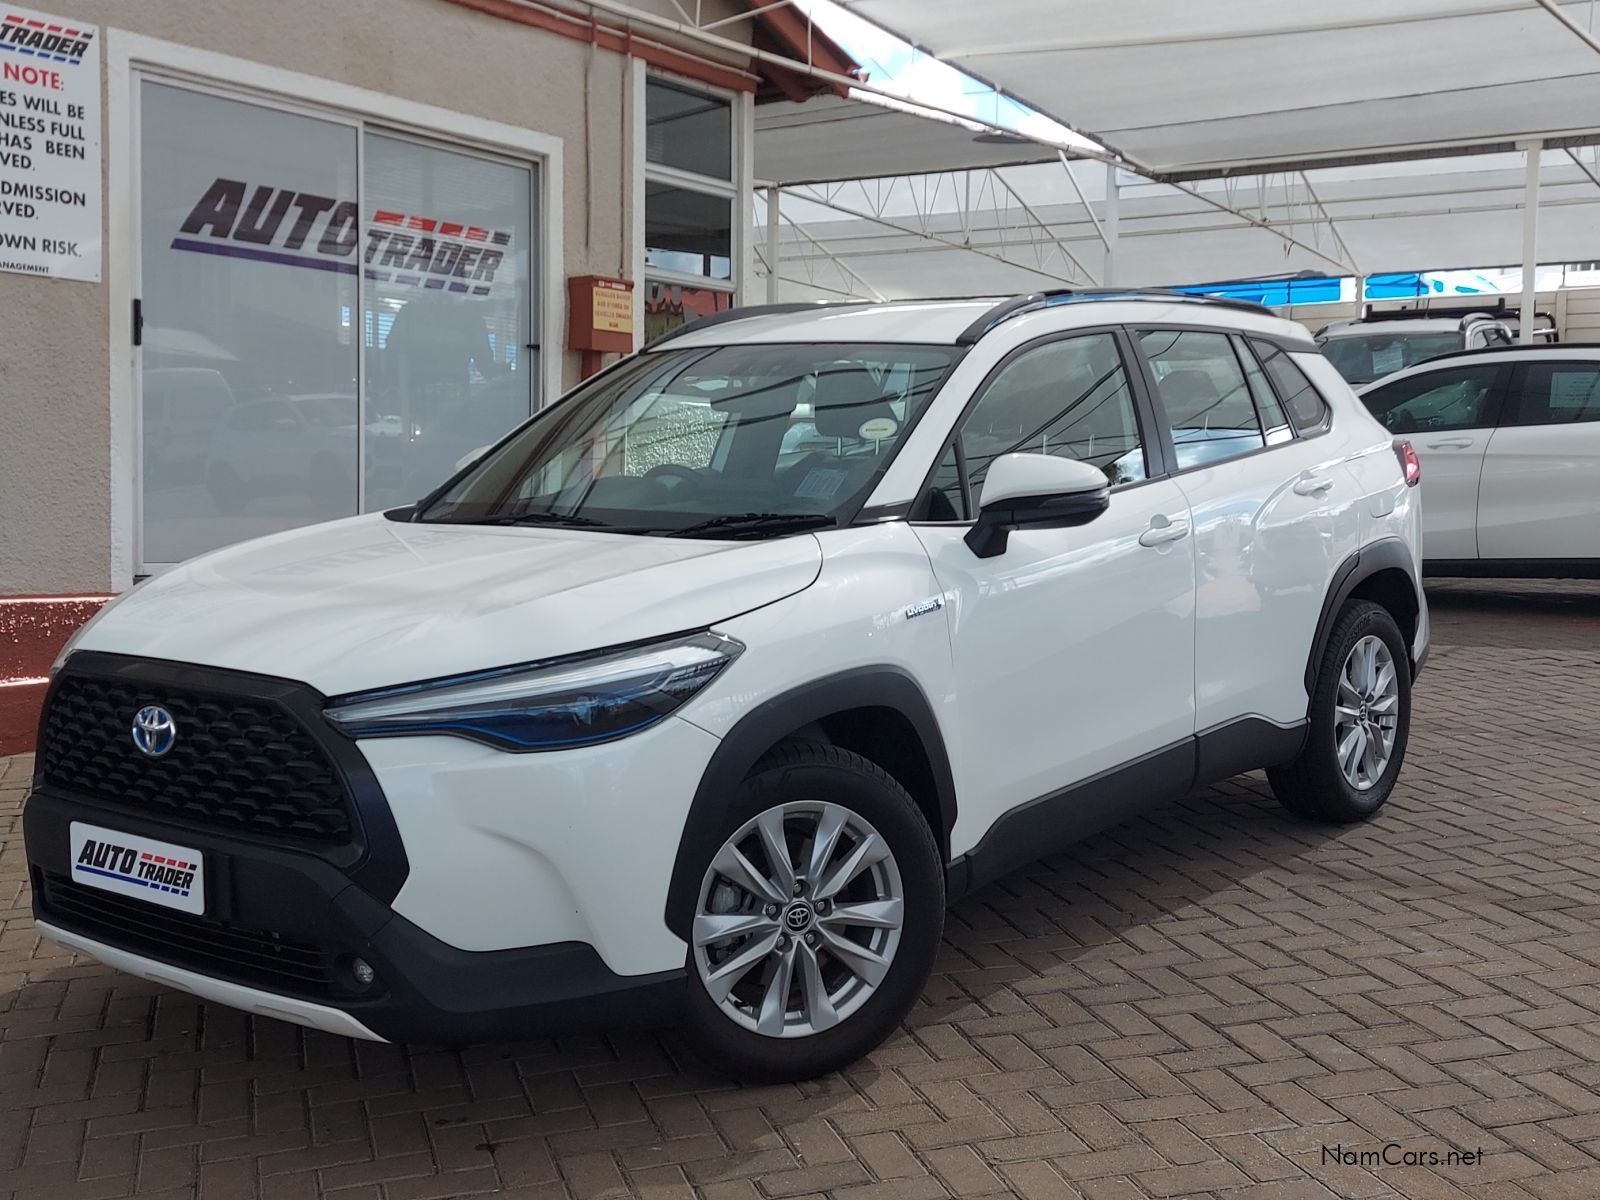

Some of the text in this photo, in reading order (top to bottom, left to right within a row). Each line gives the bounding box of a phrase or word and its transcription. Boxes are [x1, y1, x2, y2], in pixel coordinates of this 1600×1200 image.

[0, 23, 89, 58] TRADER
[4, 62, 64, 91] NOTE:
[23, 94, 61, 116] WILL
[67, 104, 85, 120] BE
[51, 121, 85, 140] FULL
[46, 140, 85, 160] BEEN
[1, 181, 85, 207] DMISSION
[0, 200, 39, 220] VED.
[179, 178, 504, 283] AUTO TRADER
[42, 238, 82, 258] RISK.
[78, 839, 194, 890] AUTO TRADER
